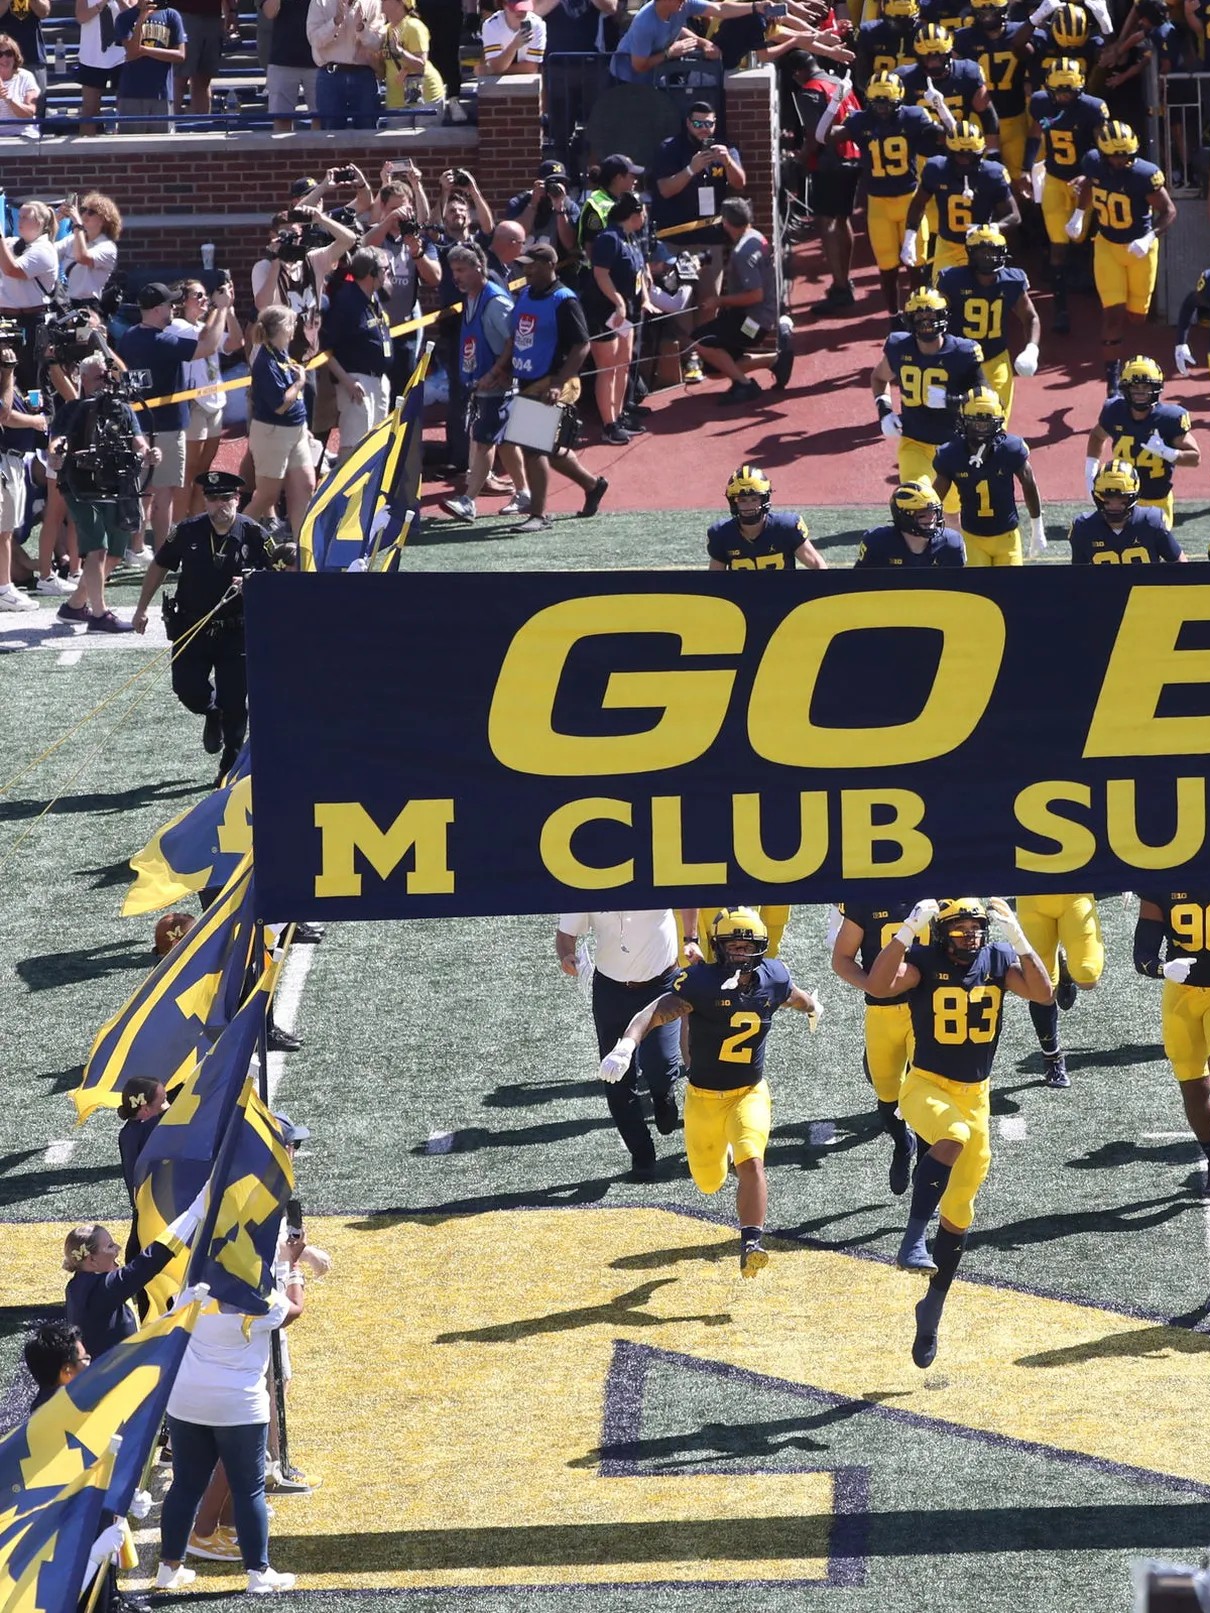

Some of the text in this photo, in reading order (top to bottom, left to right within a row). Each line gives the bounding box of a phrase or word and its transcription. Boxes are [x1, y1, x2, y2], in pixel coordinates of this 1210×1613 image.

[978, 51, 1018, 92] 17
[868, 136, 909, 177] 19
[1050, 129, 1076, 165] 5
[948, 194, 972, 232] 6
[1091, 186, 1133, 229] 50
[963, 298, 1003, 339] 91
[900, 365, 949, 407] 96
[1113, 435, 1165, 479] 44
[976, 480, 994, 517] 1
[488, 590, 1005, 776] GO
[314, 798, 455, 898] M
[540, 789, 933, 889] CLUB
[932, 985, 1002, 1045] 83
[718, 1011, 762, 1064] 2
[129, 1093, 147, 1108] M
